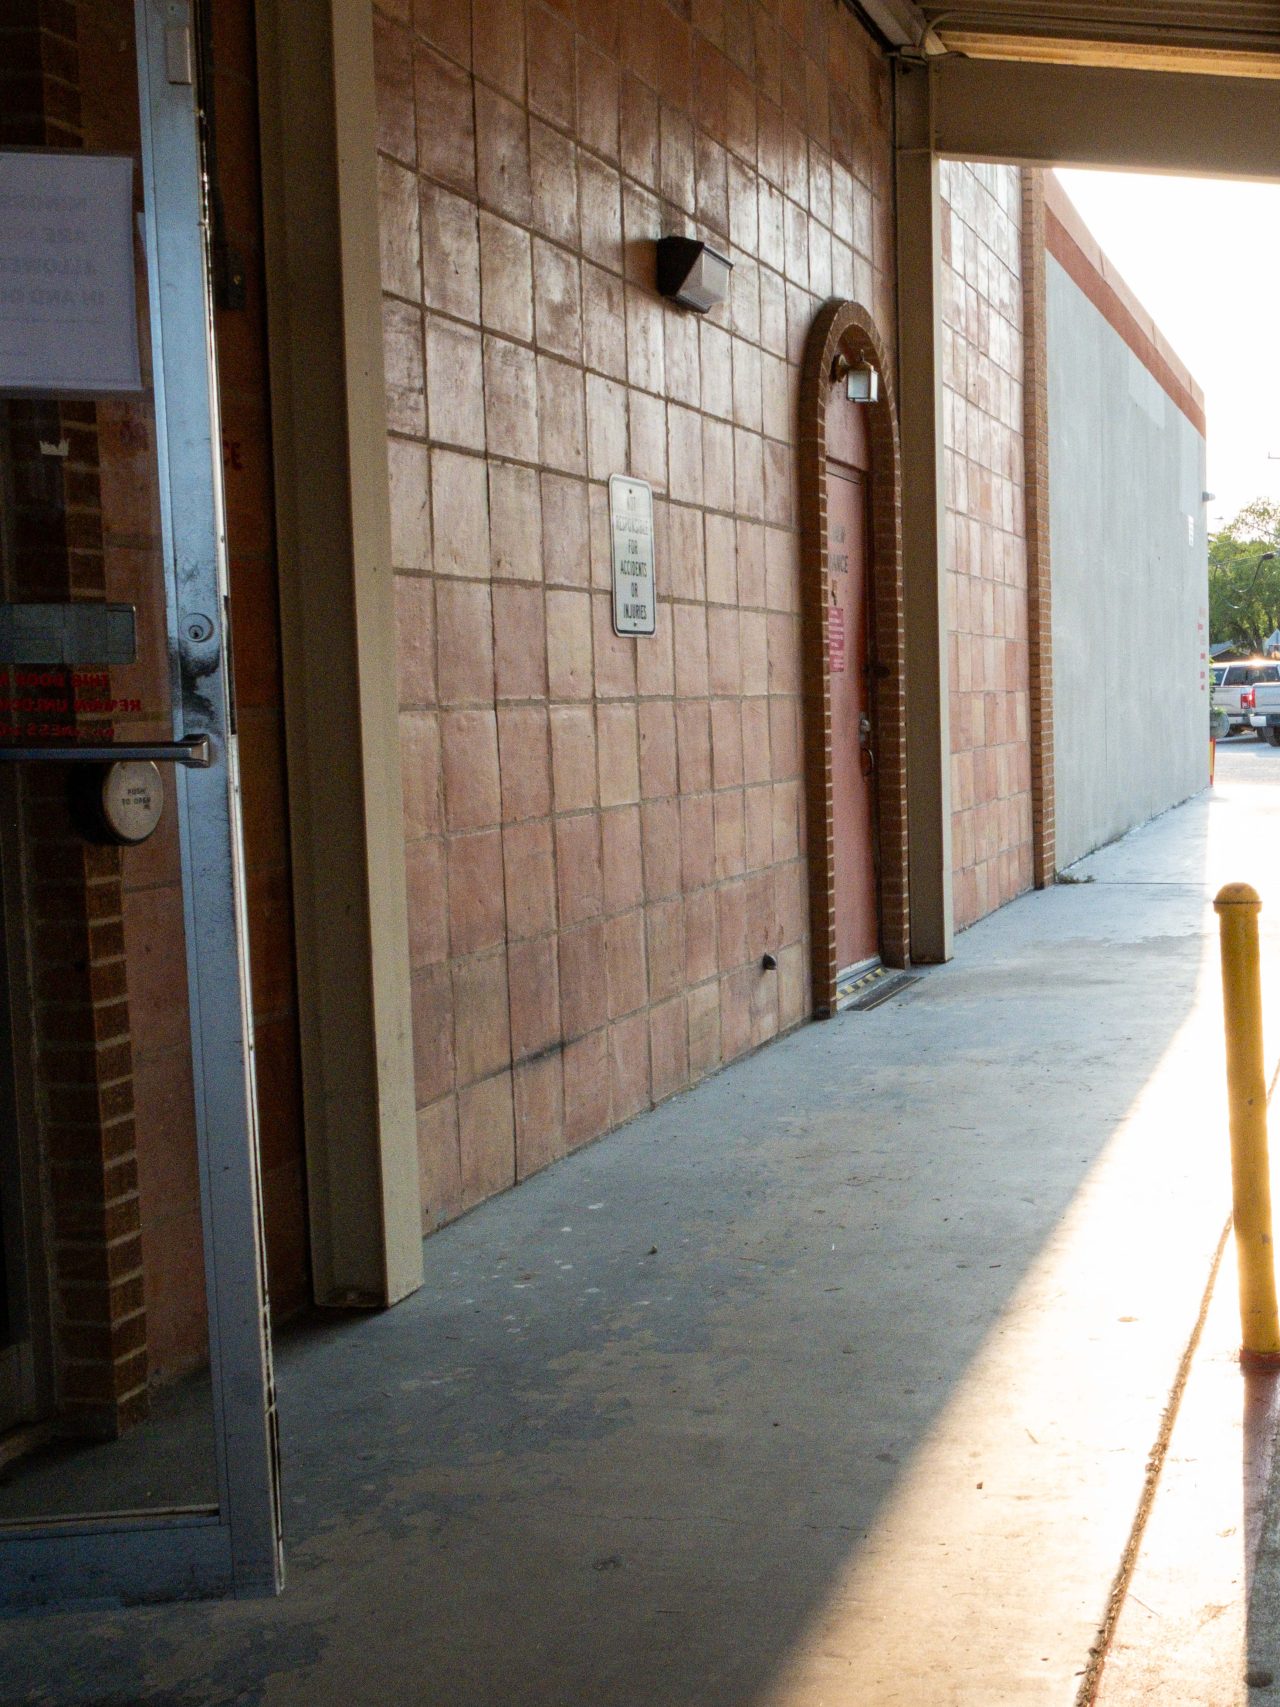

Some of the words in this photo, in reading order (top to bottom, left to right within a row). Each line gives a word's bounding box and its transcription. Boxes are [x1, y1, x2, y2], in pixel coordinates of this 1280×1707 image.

[628, 539, 638, 555] FOR
[620, 561, 647, 578] ACCIDENTS
[631, 582, 638, 597] OR
[624, 604, 647, 620] INJURIES
